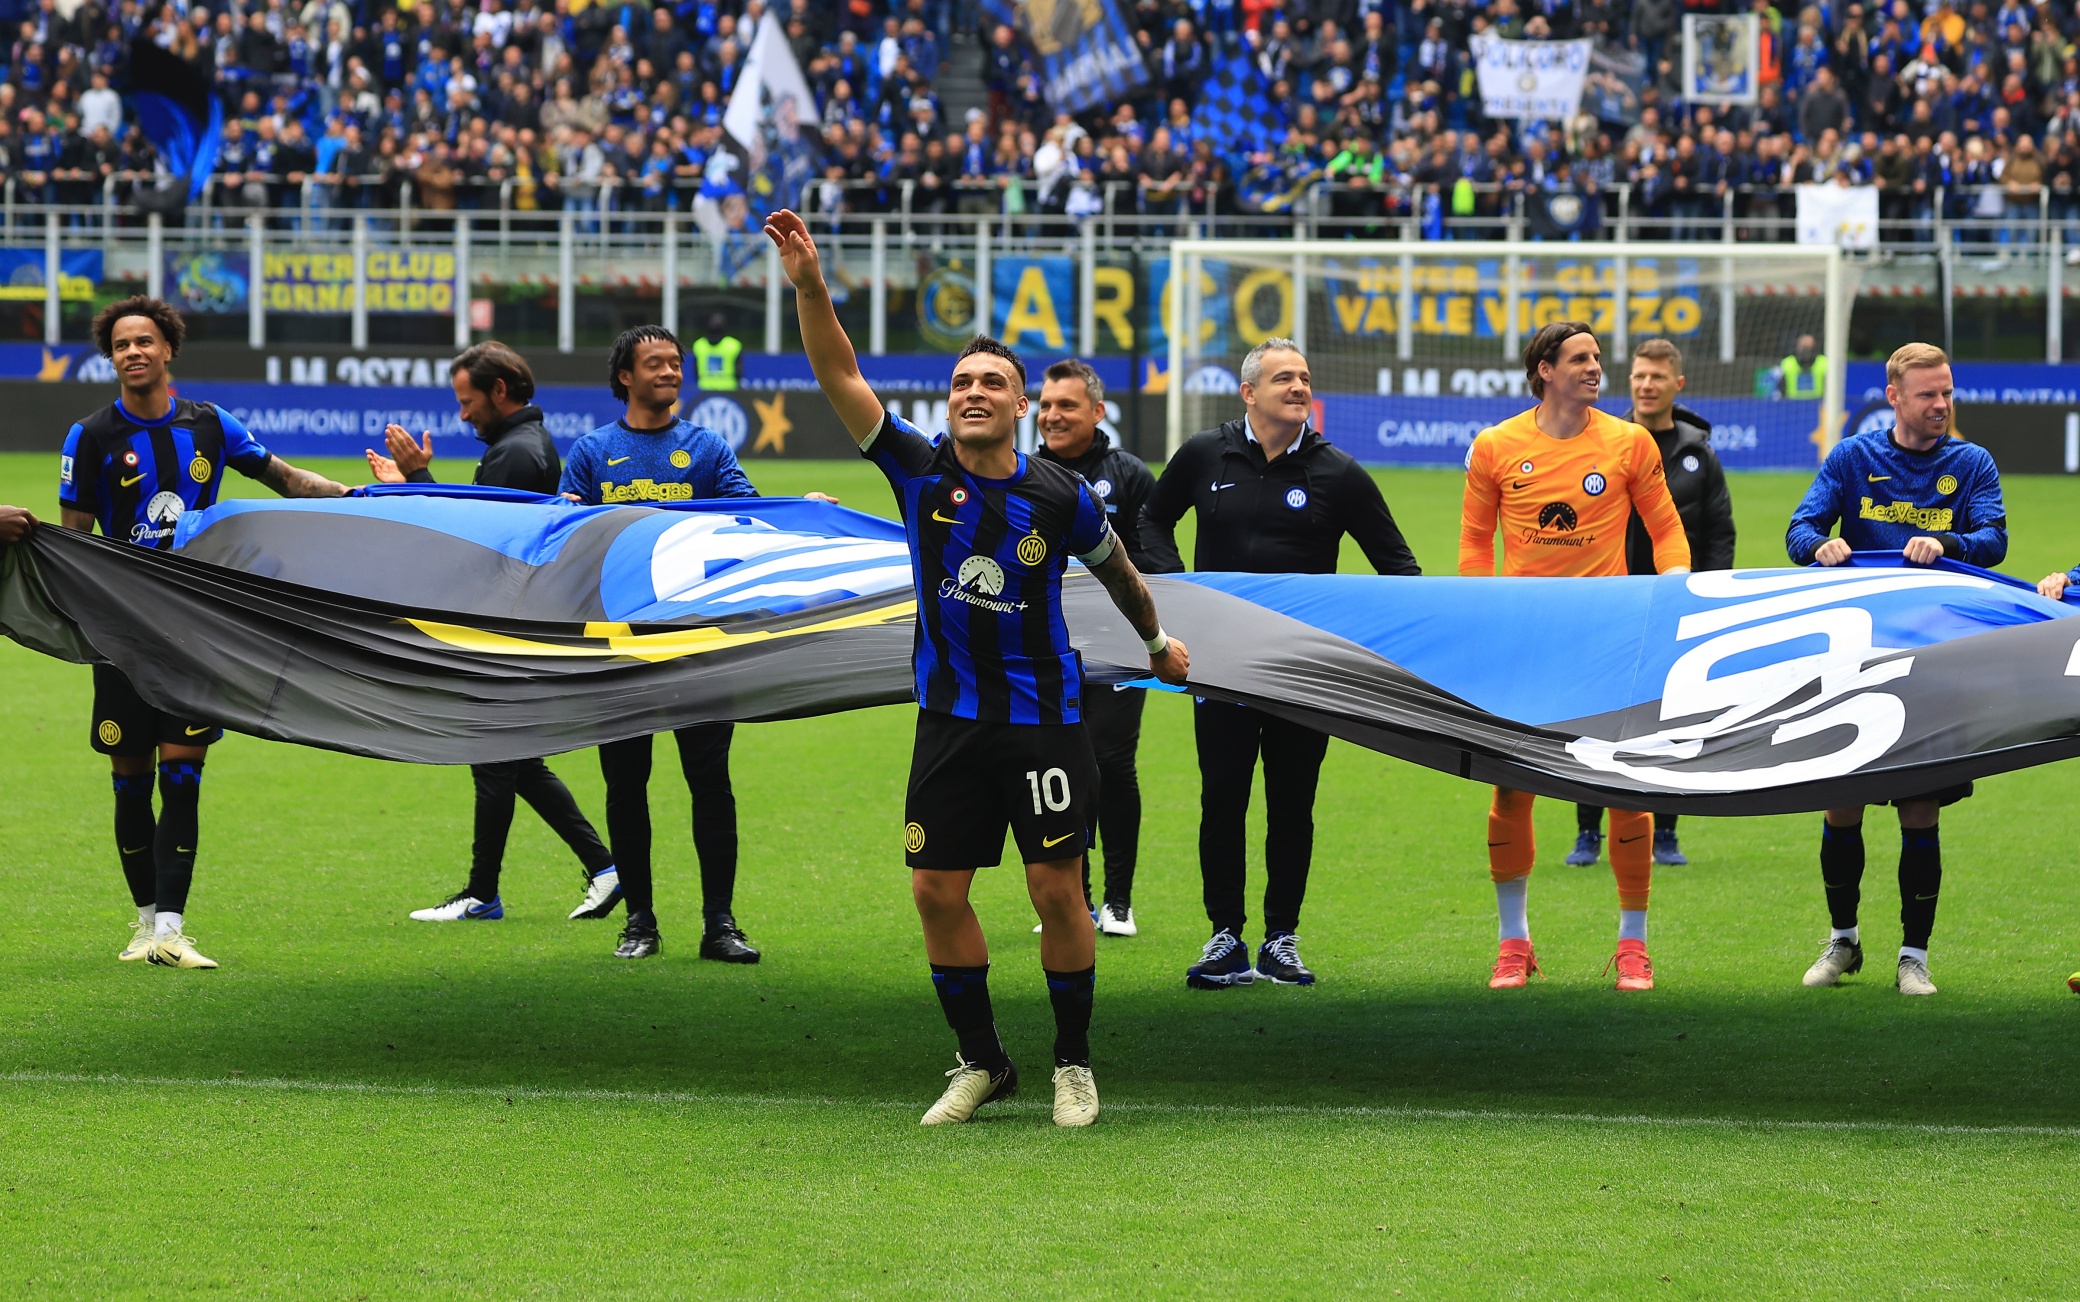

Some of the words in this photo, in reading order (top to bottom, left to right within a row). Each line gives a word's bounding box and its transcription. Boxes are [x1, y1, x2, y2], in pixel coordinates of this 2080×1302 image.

[263, 252, 355, 280] NTER
[262, 281, 453, 312] ORNAREDO
[232, 407, 361, 437] CAMPIONI
[1376, 419, 1494, 448] CAMPIO
[601, 479, 693, 503] LeoVegas
[1859, 497, 1953, 529] LeoVegas
[129, 523, 175, 544] Paramo
[1026, 767, 1071, 815] 10
